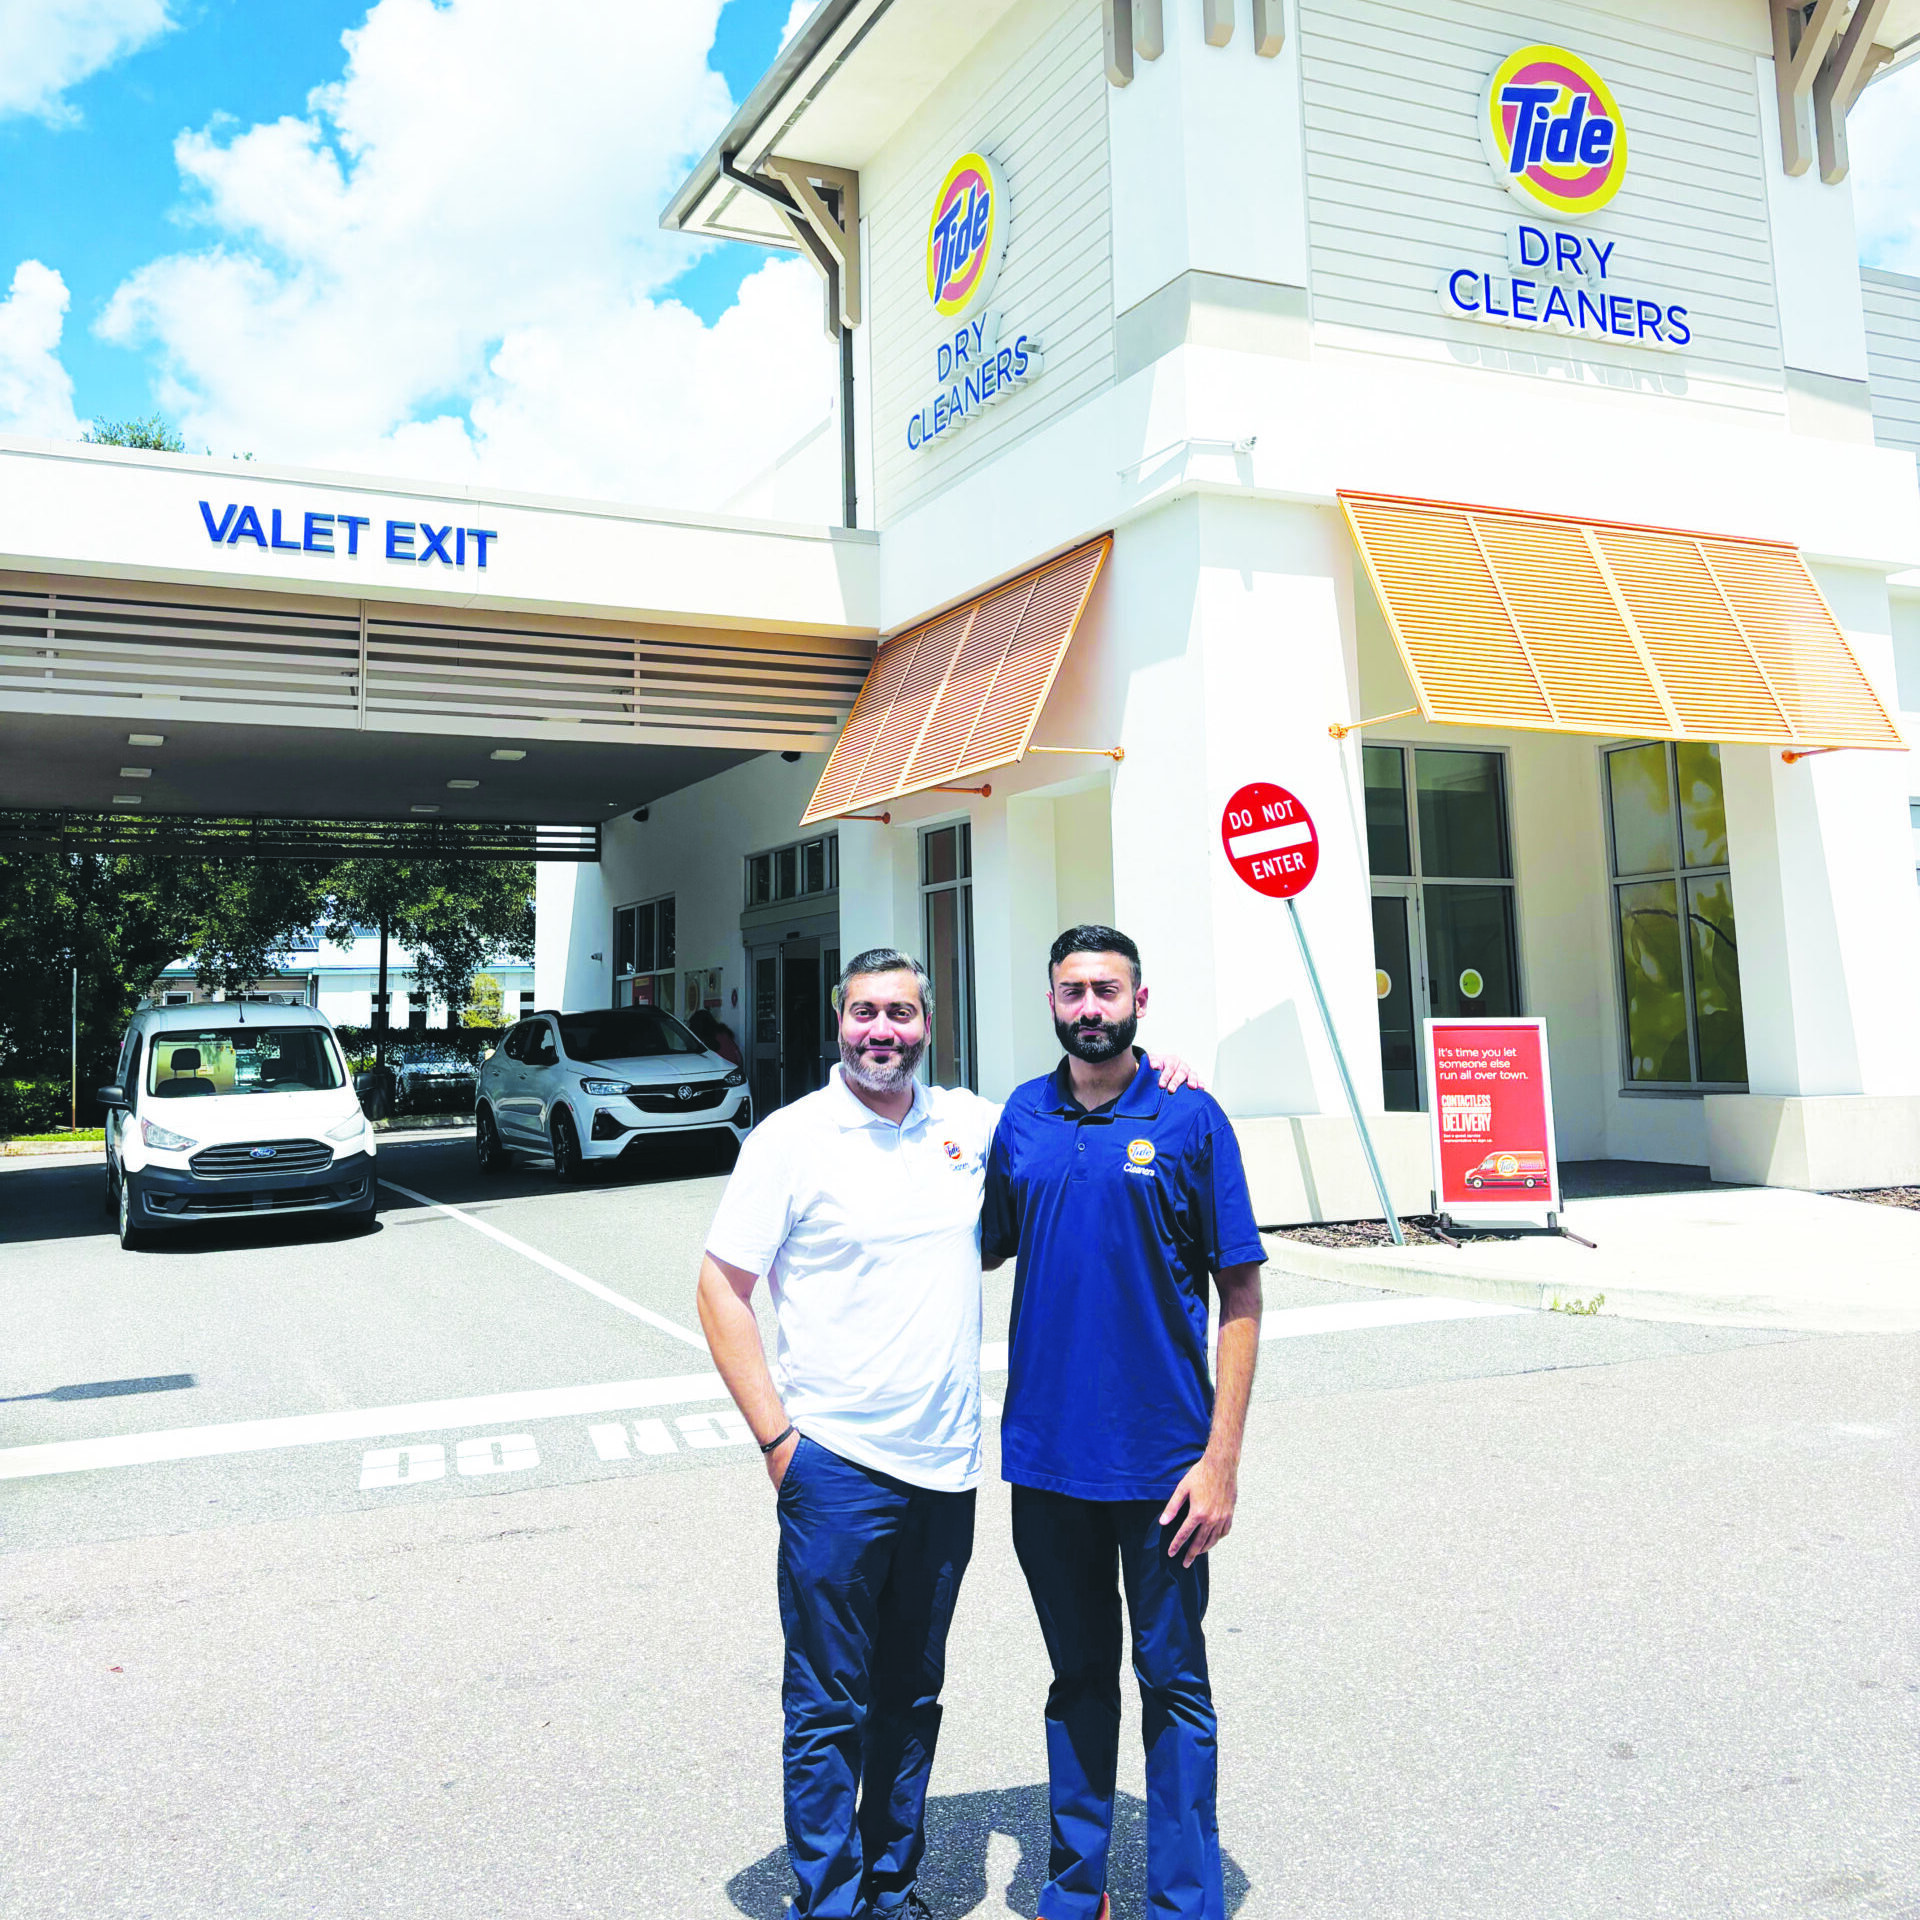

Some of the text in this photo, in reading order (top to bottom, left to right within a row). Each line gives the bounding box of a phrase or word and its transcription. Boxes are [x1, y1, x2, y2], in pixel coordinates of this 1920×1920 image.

[1499, 85, 1616, 175] Tide
[932, 181, 990, 305] Tide
[1518, 225, 1616, 279] DRY
[1449, 269, 1692, 346] CLEANERS
[937, 312, 987, 383] DRY
[907, 335, 1029, 451] CLEANERS
[199, 500, 498, 567] VALET EXIT
[1229, 800, 1294, 830] DO NOT
[1251, 852, 1306, 880] ENTER
[1438, 1047, 1517, 1059] It's time you let
[1439, 1059, 1511, 1069] someone else
[1440, 1070, 1529, 1080] run all over town.
[1441, 1094, 1491, 1107] CONTACTLESS
[1443, 1113, 1491, 1132] DELIVERY
[1123, 1162, 1156, 1177] Cleaners
[359, 1410, 763, 1491] DO NO
